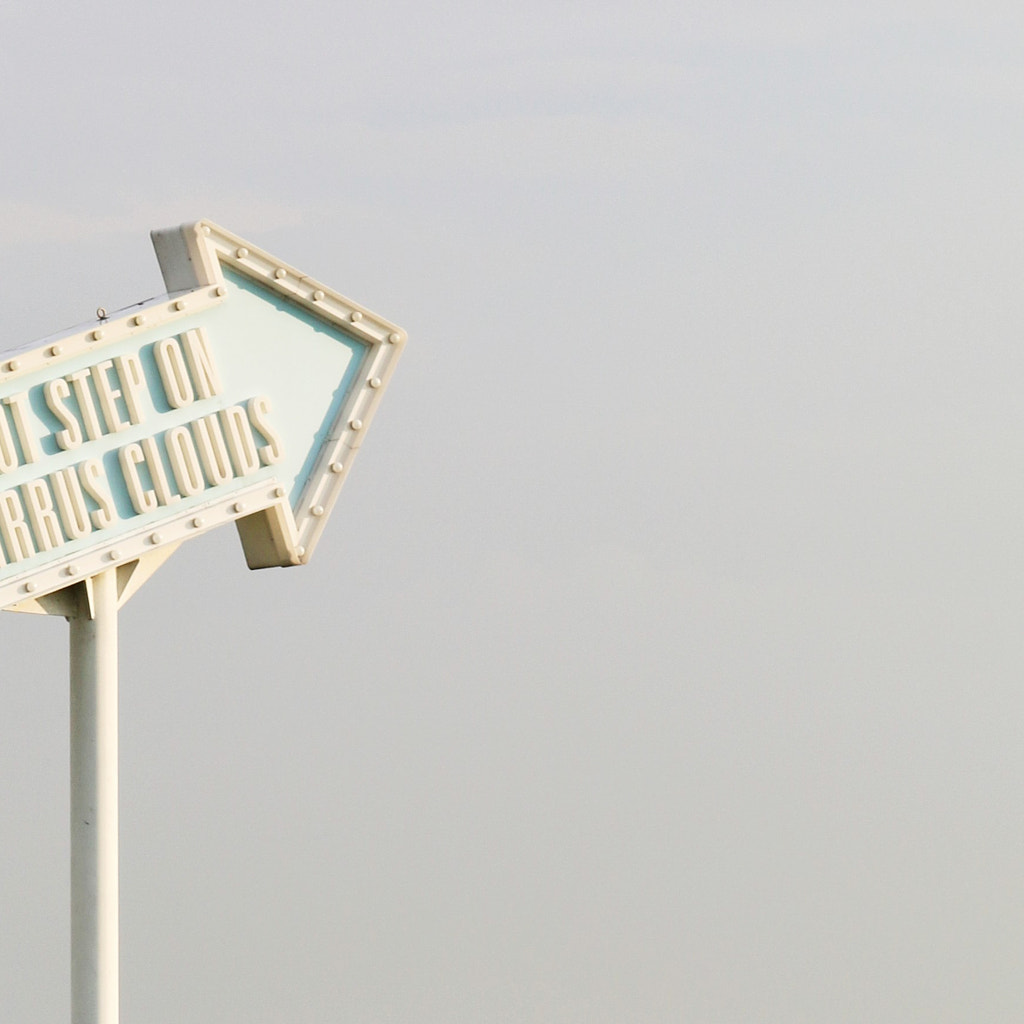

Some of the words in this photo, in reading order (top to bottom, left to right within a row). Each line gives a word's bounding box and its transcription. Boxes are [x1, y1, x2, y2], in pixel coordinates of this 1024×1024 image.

[43, 354, 147, 451] STEP
[153, 326, 224, 410] ON
[118, 396, 285, 515] CLOUDS
